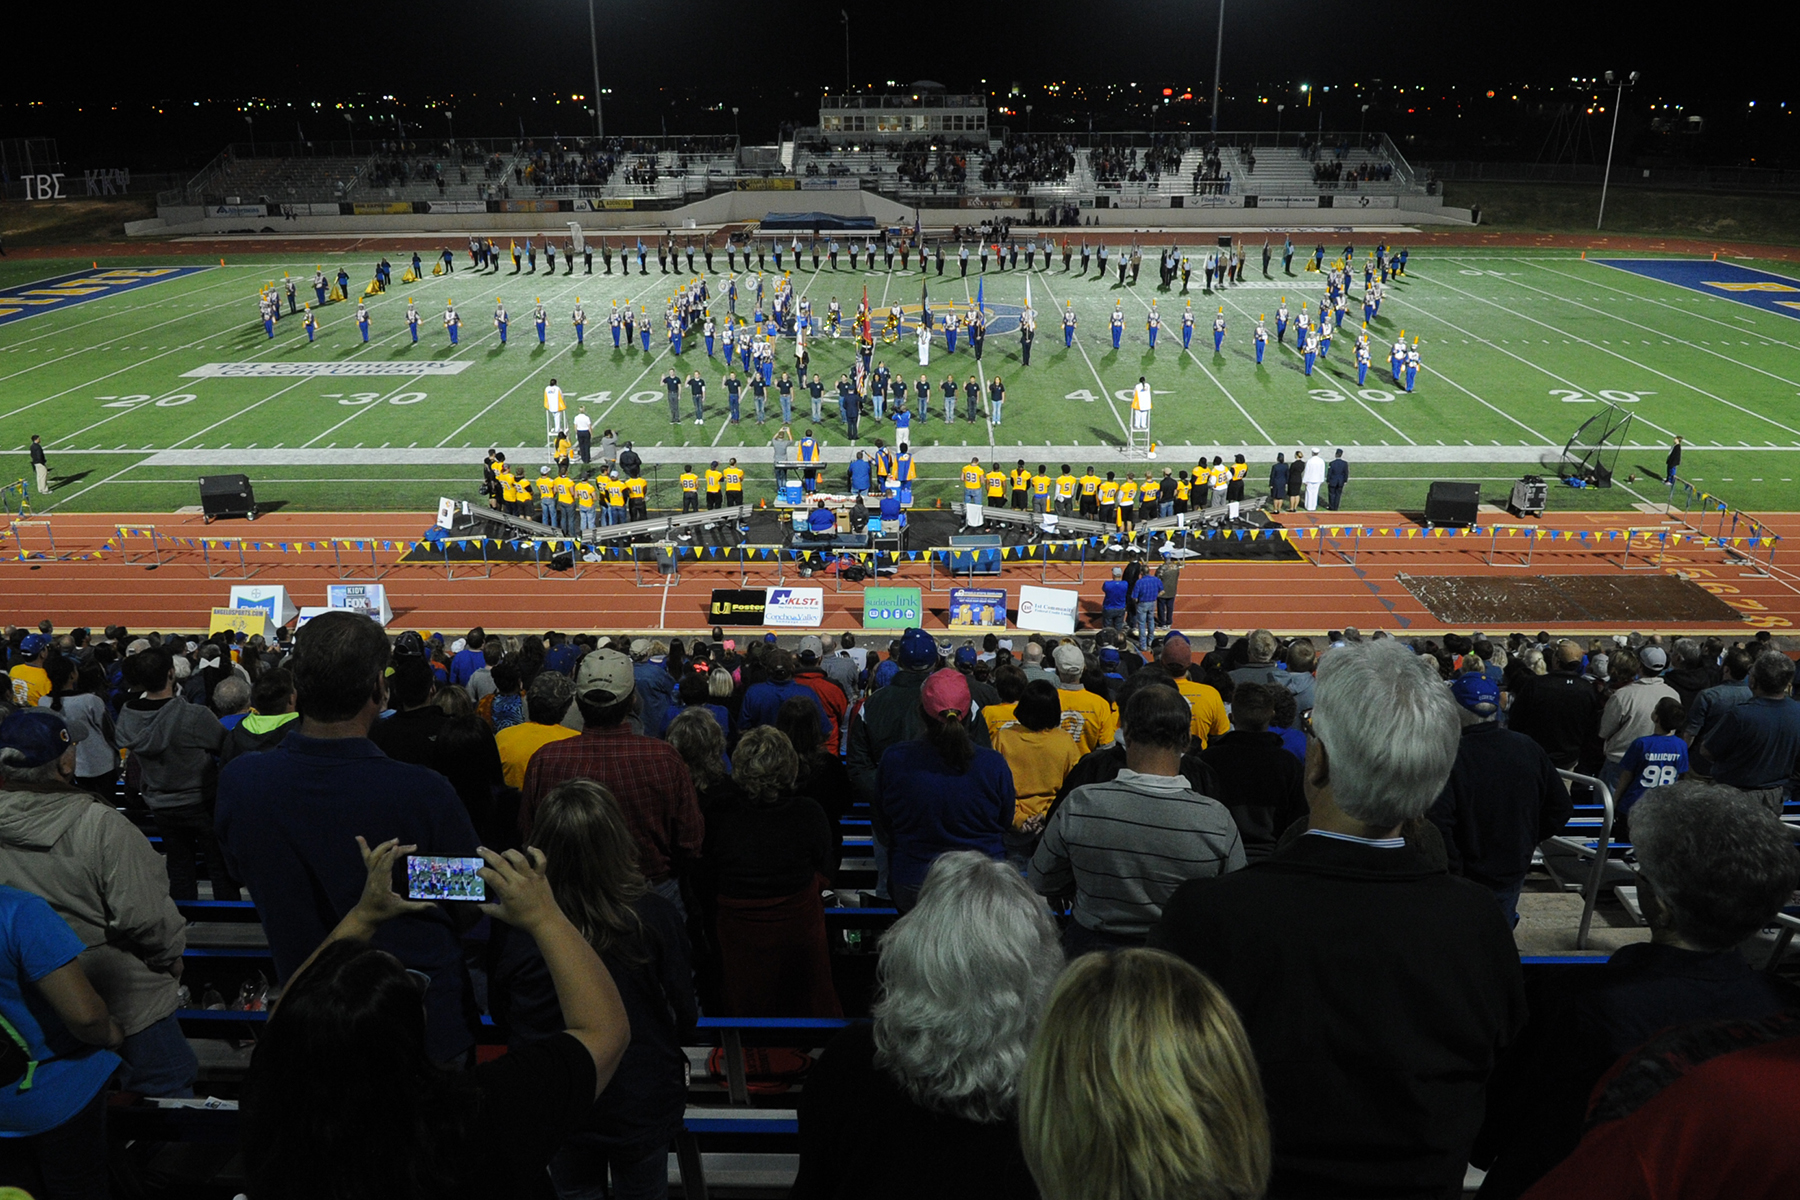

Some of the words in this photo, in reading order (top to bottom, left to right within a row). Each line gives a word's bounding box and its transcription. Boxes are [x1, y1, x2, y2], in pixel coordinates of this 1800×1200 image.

[330, 367, 425, 375] Union
[347, 586, 364, 595] KIDY
[346, 598, 367, 609] FOX
[866, 594, 918, 607] suddenlink
[213, 608, 264, 617] ANGELOSPORTS.COM
[765, 612, 792, 621] Concho
[797, 613, 819, 623] Valley
[1640, 765, 1677, 788] 98
